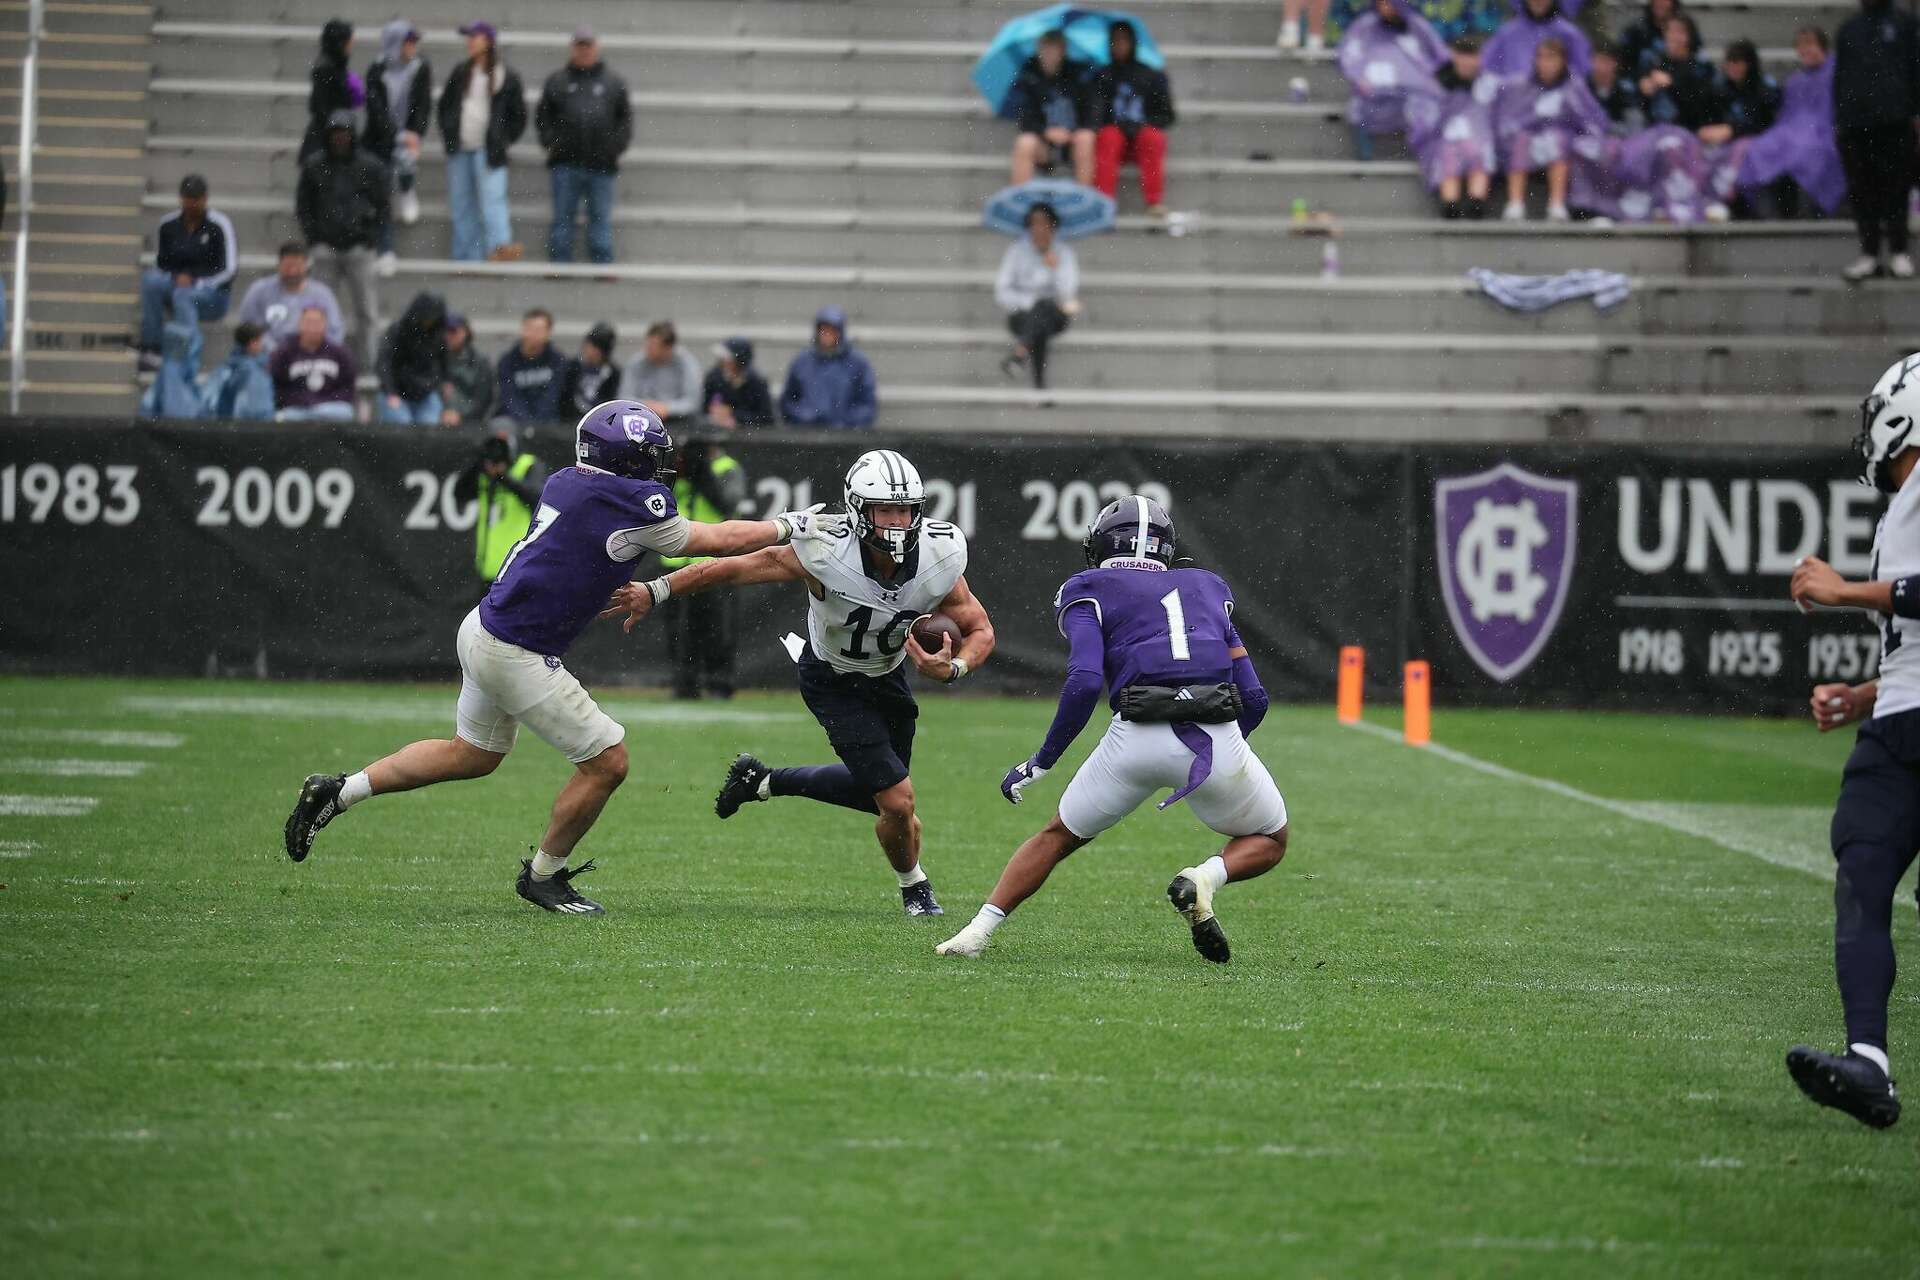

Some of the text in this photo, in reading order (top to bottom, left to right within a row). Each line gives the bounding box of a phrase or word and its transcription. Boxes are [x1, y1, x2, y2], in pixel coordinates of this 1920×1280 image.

[0, 462, 140, 525] 1983
[195, 466, 355, 528] 2009
[496, 503, 562, 583] 7
[926, 521, 954, 540] 10
[1616, 476, 1896, 575] UNDE
[1110, 561, 1163, 573] CRUSADERS
[840, 606, 923, 660] 10
[1160, 587, 1191, 661] 1
[1618, 628, 1880, 679] 1918 1935 1937
